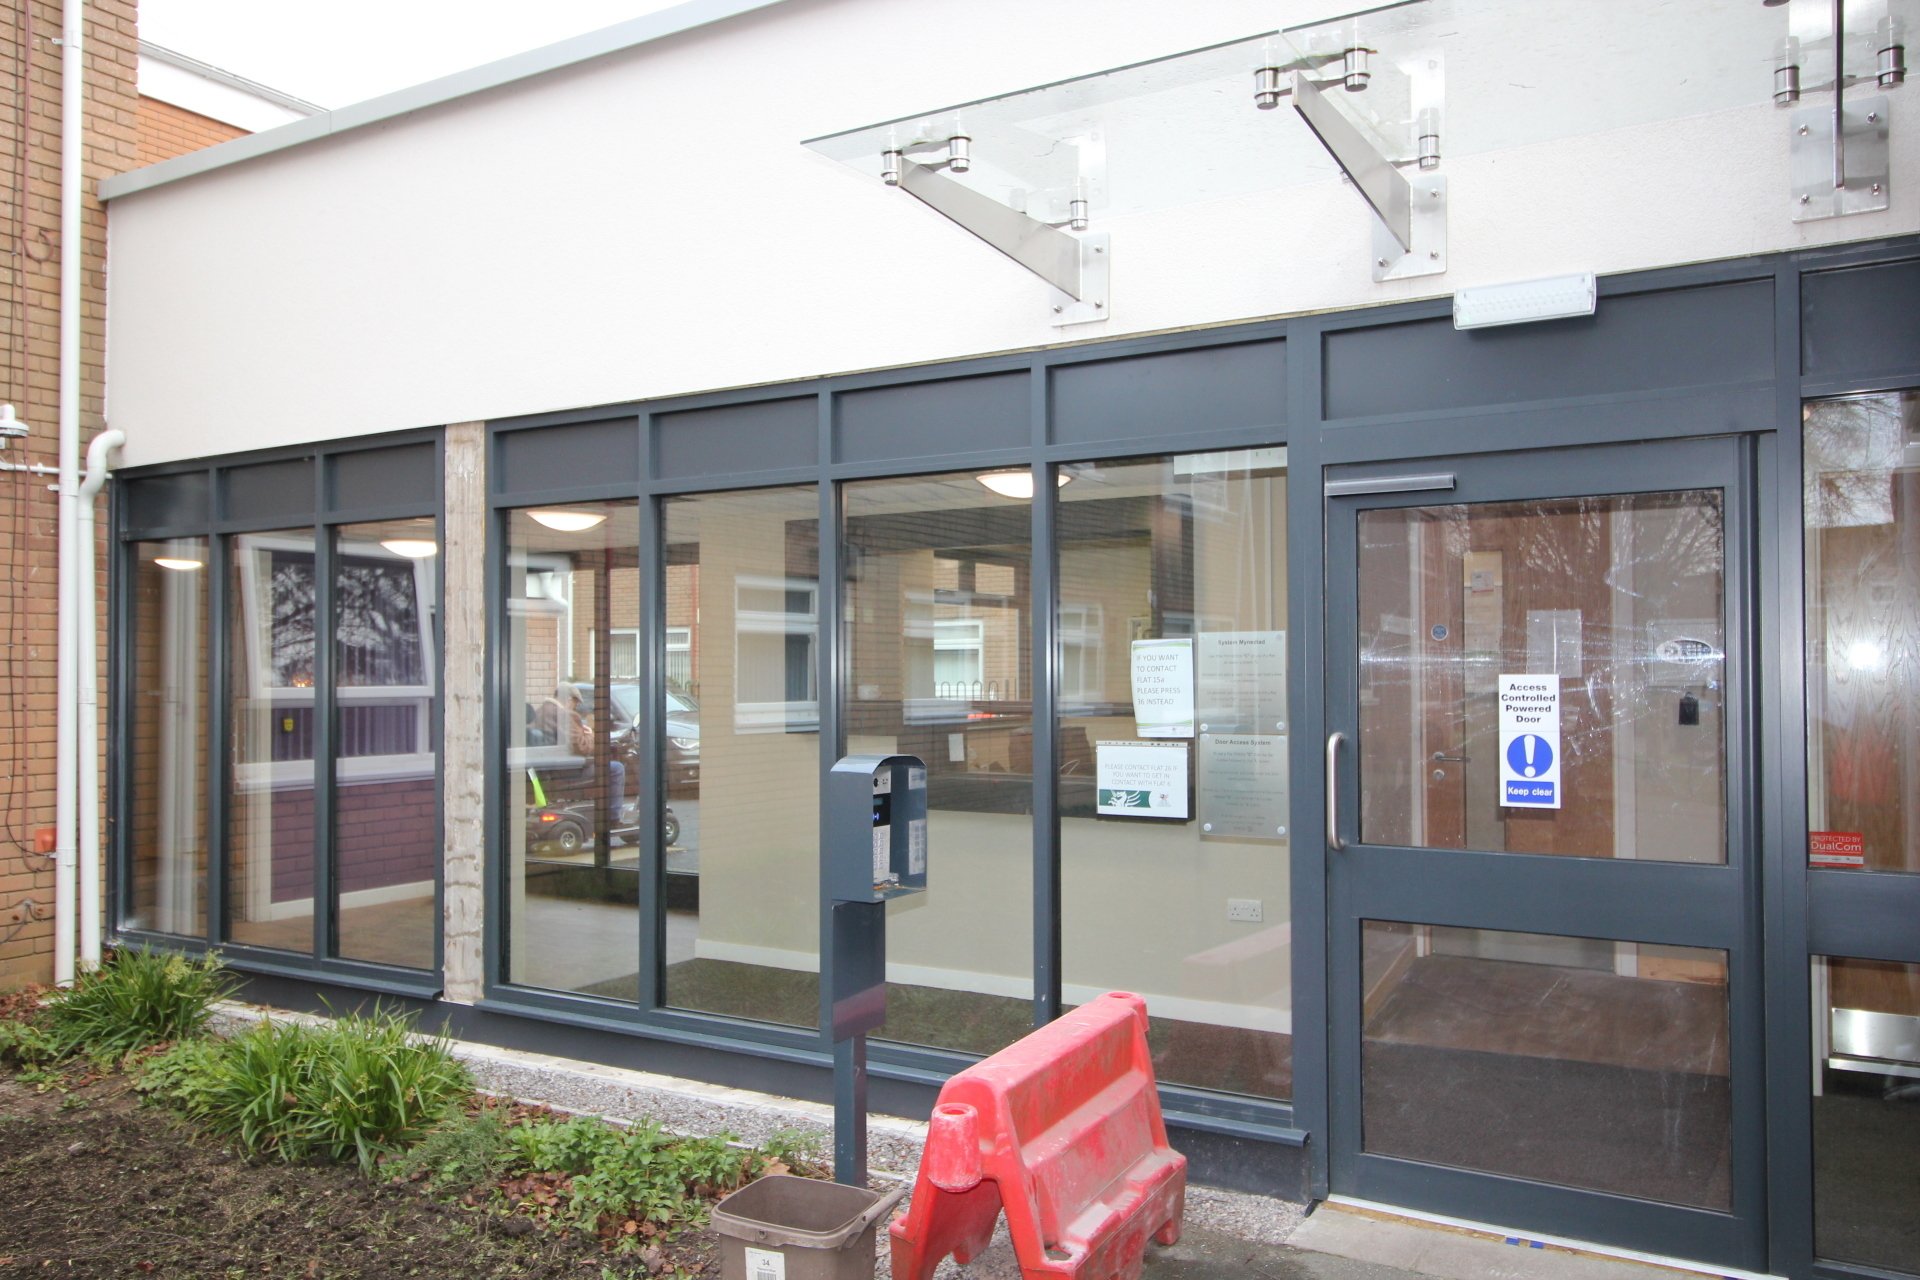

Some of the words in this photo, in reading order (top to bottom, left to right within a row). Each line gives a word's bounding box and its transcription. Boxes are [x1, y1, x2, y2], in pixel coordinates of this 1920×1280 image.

[1158, 653, 1179, 661] WANT
[1509, 683, 1547, 691] Access
[1501, 694, 1556, 702] Controlled
[1505, 704, 1552, 713] Powered
[1516, 715, 1541, 723] Door
[1124, 763, 1150, 771] CONTACT
[1507, 786, 1529, 797] Keep
[1531, 787, 1553, 797] clear
[1811, 841, 1862, 851] DualCom
